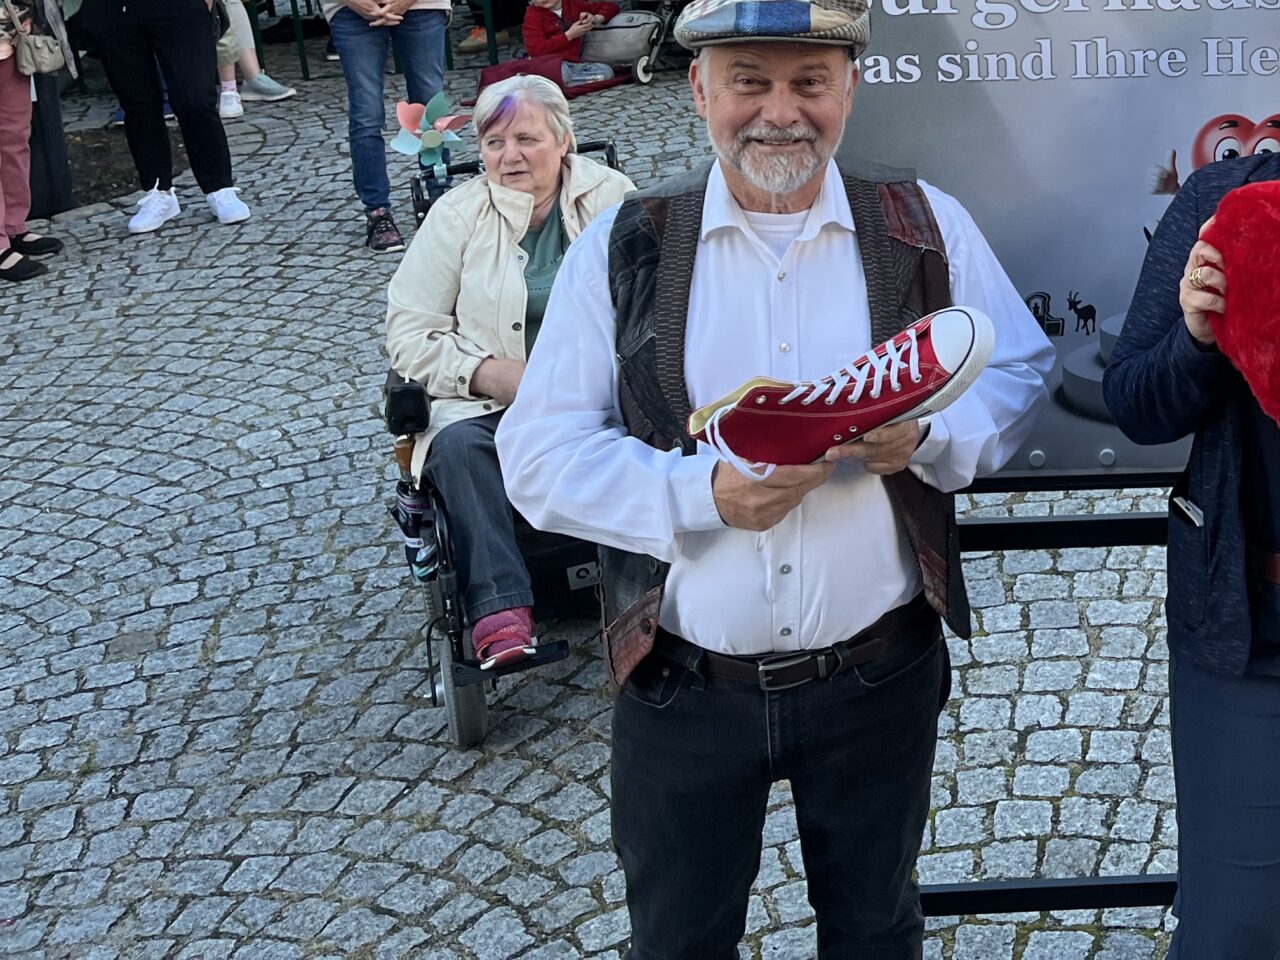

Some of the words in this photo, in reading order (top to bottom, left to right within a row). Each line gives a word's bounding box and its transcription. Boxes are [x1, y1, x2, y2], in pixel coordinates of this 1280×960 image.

[855, 53, 923, 84] as
[937, 38, 1058, 83] sind
[1069, 36, 1189, 81] Ihre
